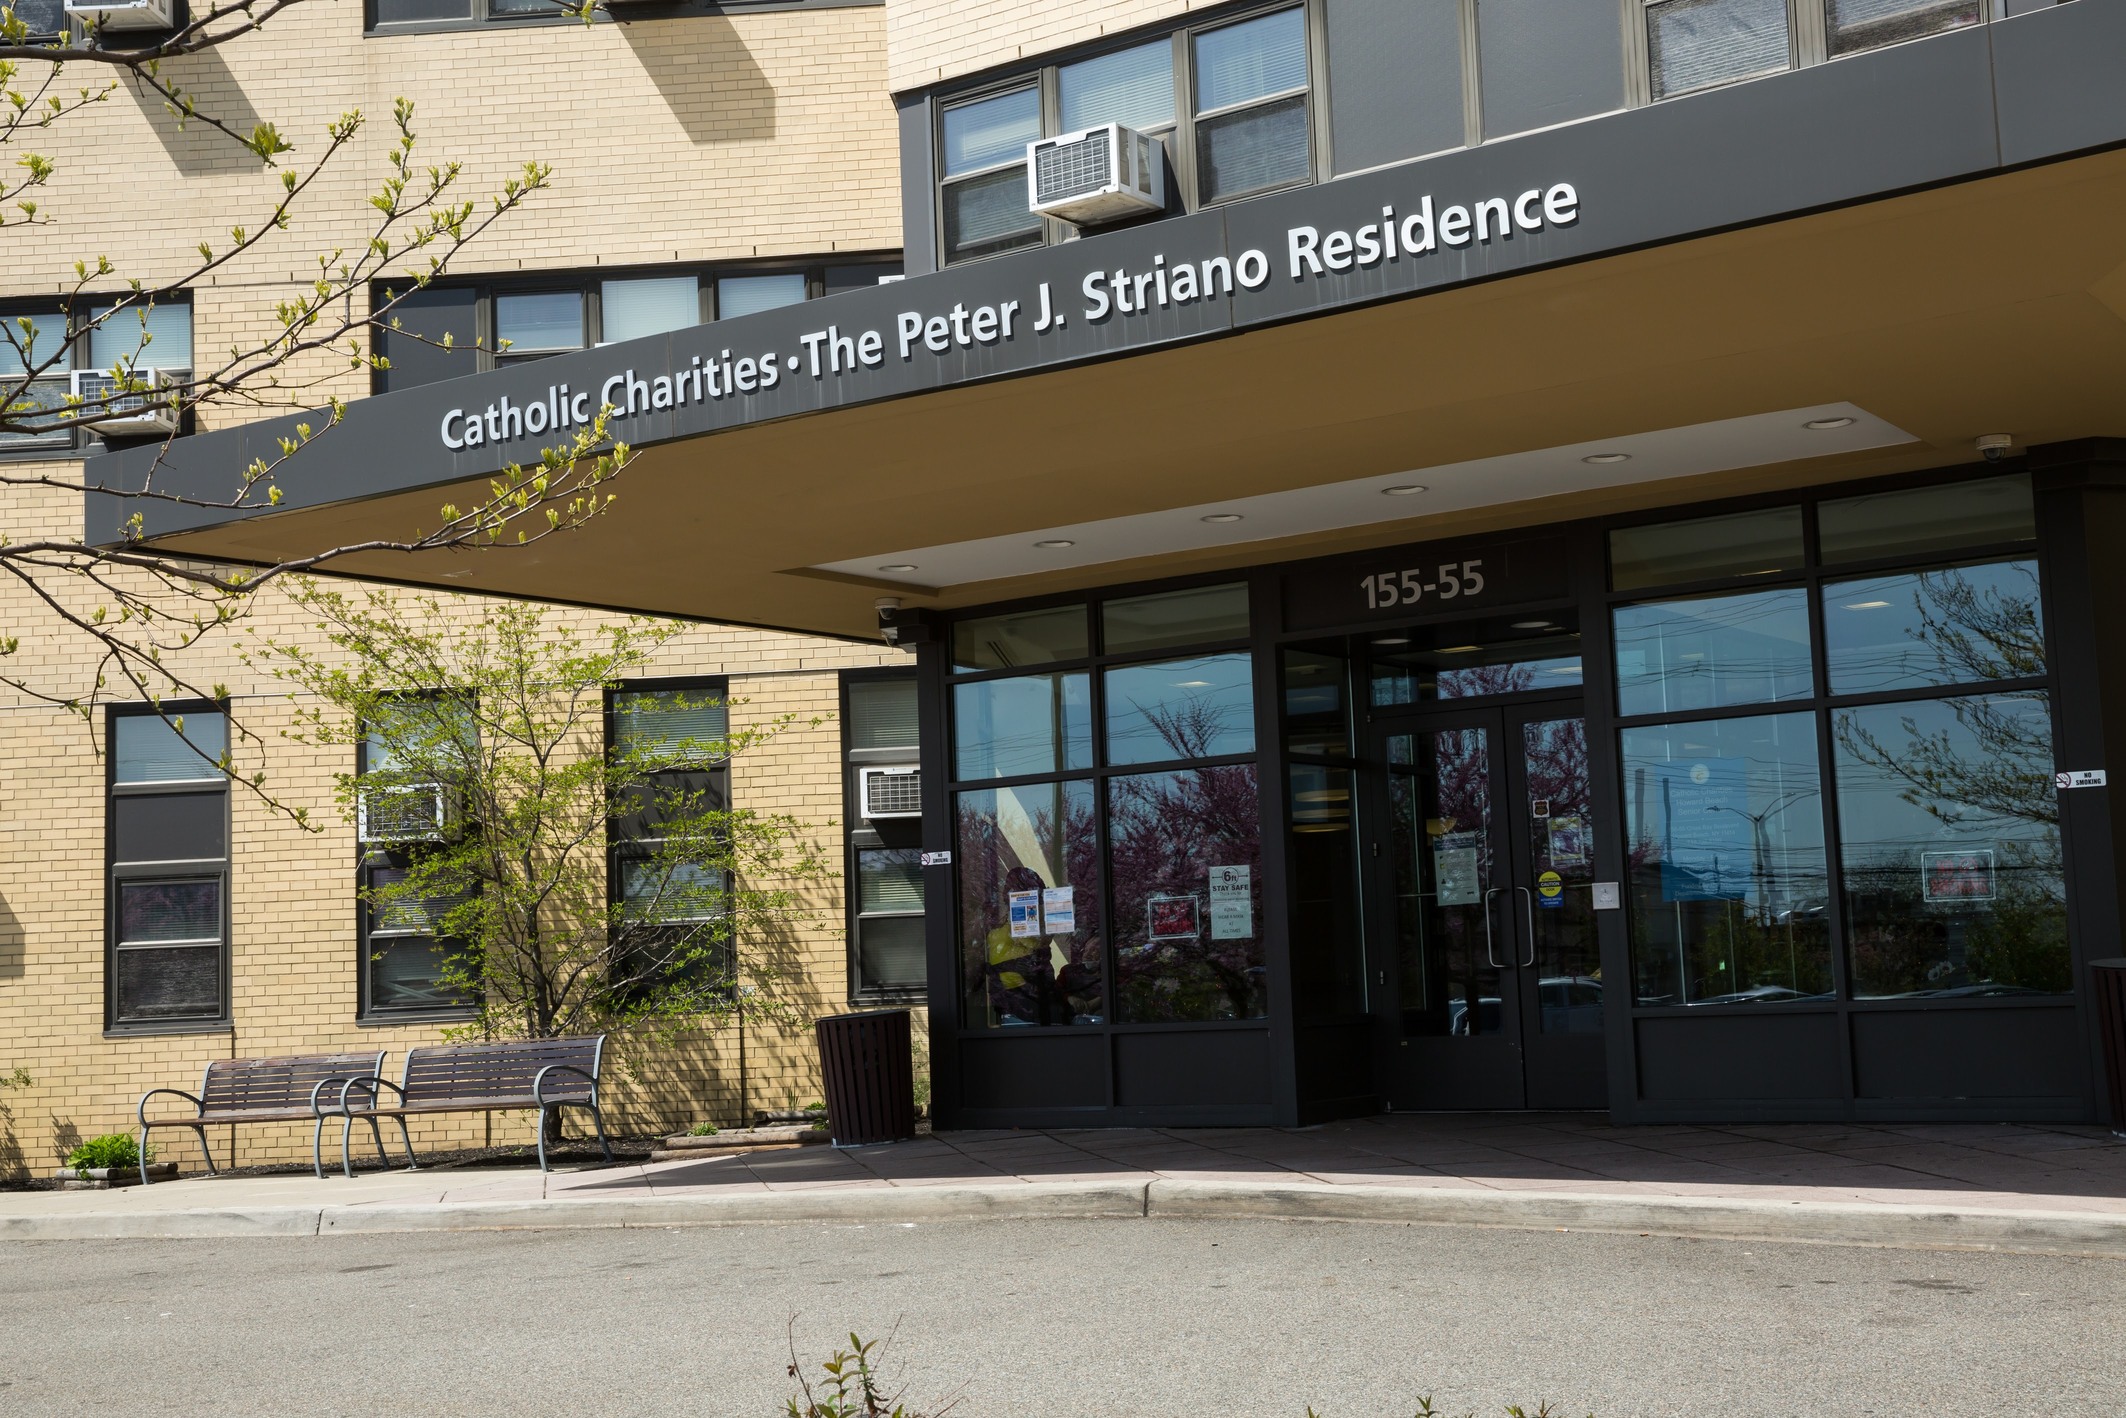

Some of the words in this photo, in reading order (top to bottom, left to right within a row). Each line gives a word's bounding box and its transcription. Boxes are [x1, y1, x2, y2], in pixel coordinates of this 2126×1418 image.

[441, 384, 590, 449] Catholic
[601, 349, 779, 417] Charities
[800, 324, 884, 377] The
[897, 300, 1019, 358] Peter
[1034, 283, 1066, 332] J.
[1082, 249, 1270, 320] Striano
[1288, 183, 1579, 278] Residence
[1360, 559, 1485, 609] 155-55
[2075, 778, 2101, 786] SMOKING
[1704, 795, 1728, 804] Beach
[1224, 870, 1237, 882] 6ft
